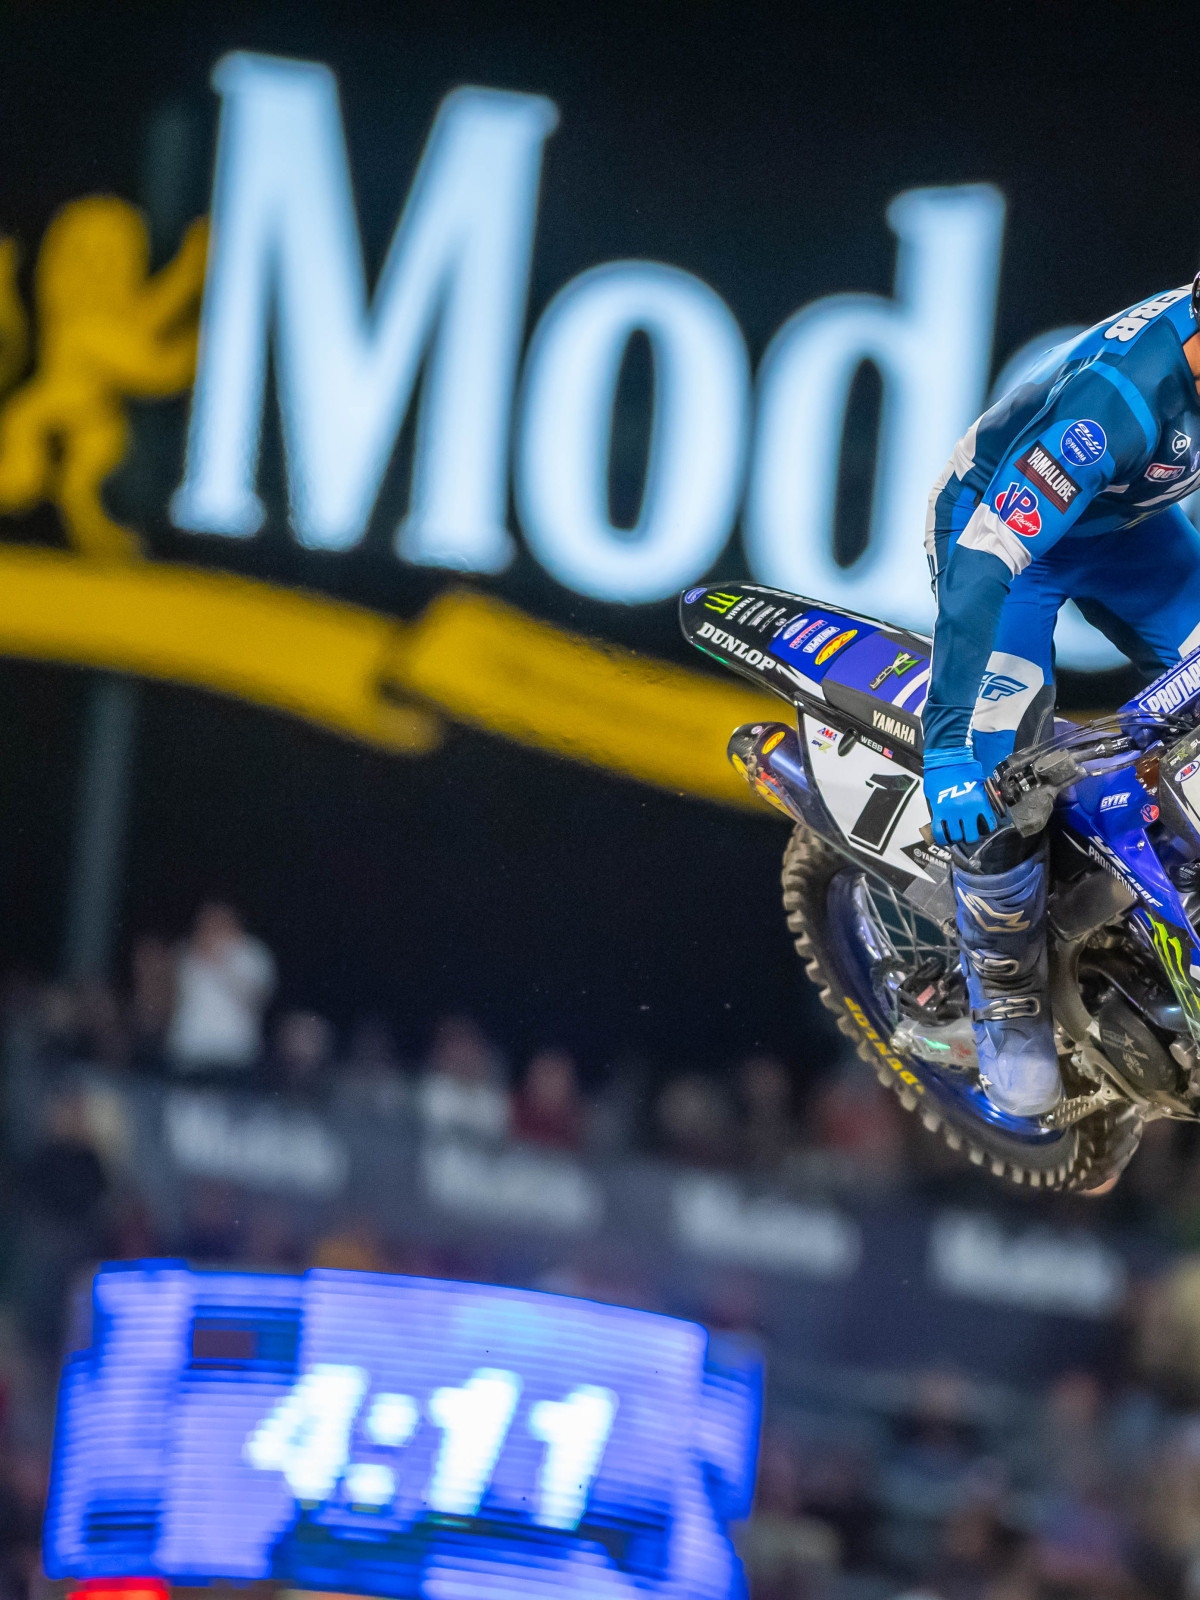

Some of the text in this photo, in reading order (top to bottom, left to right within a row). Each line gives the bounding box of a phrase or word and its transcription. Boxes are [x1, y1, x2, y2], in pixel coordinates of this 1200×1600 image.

[1026, 446, 1081, 503] YAMALUBE
[999, 482, 1039, 523] VP
[1010, 511, 1039, 533] Racing
[696, 621, 777, 672] DUNLOP
[817, 727, 838, 743] AMA
[872, 709, 916, 745] YAMAHA
[861, 735, 883, 752] WEBB
[1180, 764, 1197, 781] AMA
[937, 781, 977, 804] FLY
[1101, 792, 1131, 809] GYTR
[847, 772, 921, 856] 1
[921, 852, 949, 870] YAMAHA
[246, 1362, 618, 1532] 4:11
